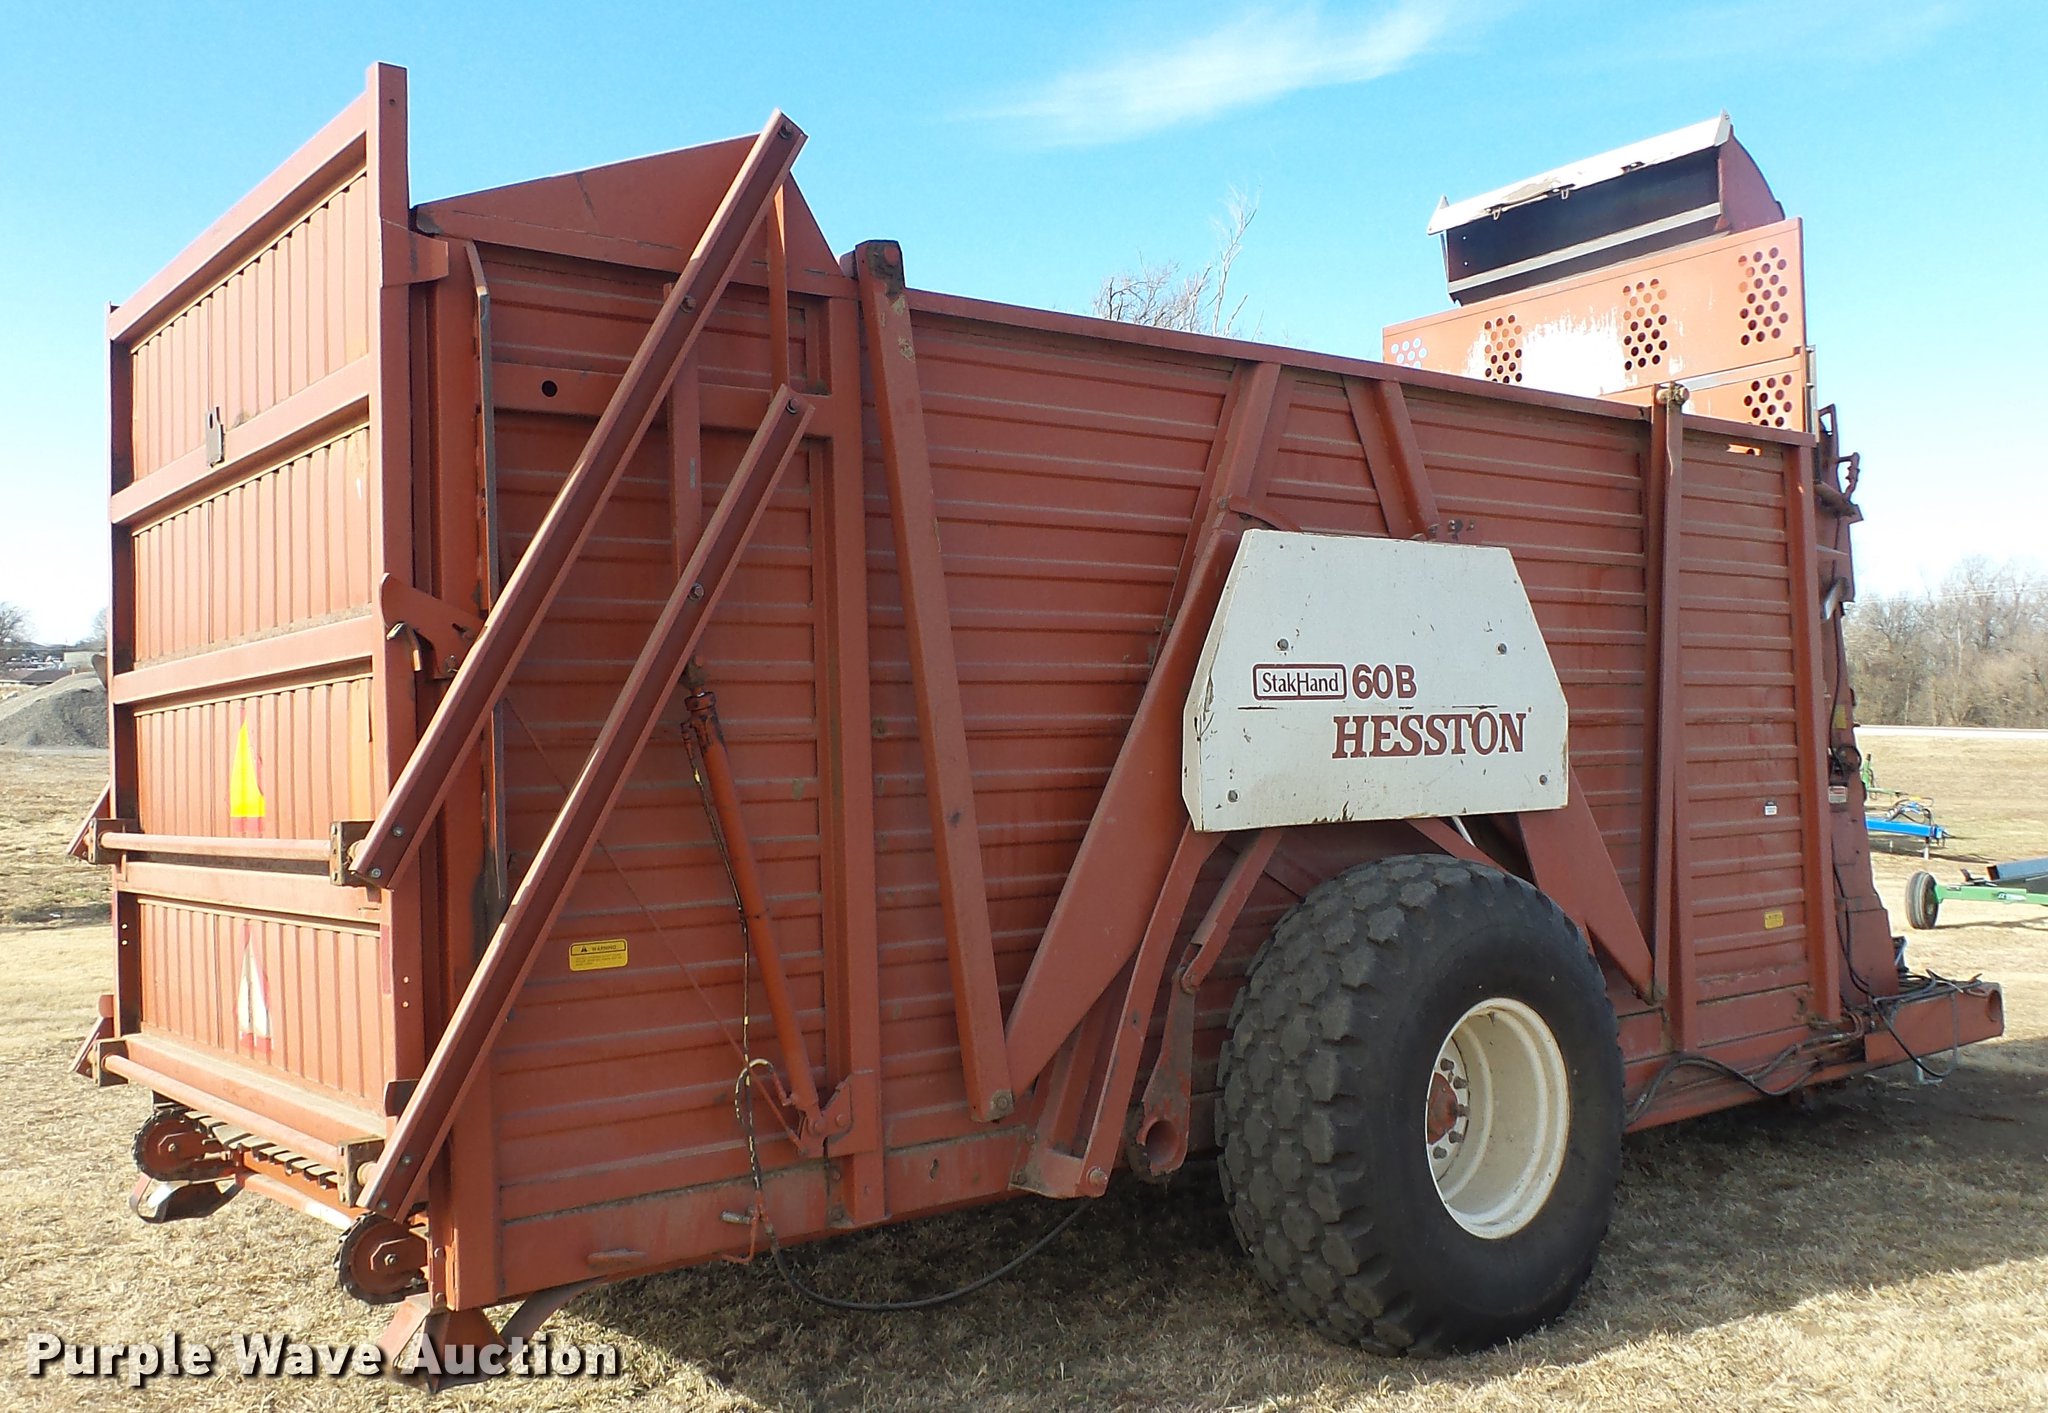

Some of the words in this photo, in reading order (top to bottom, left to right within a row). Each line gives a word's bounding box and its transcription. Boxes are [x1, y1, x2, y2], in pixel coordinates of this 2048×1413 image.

[1262, 672, 1339, 696] StakHand
[1352, 664, 1417, 699] 60B
[1332, 711, 1527, 759] HESSTON
[591, 944, 618, 952] WARNING
